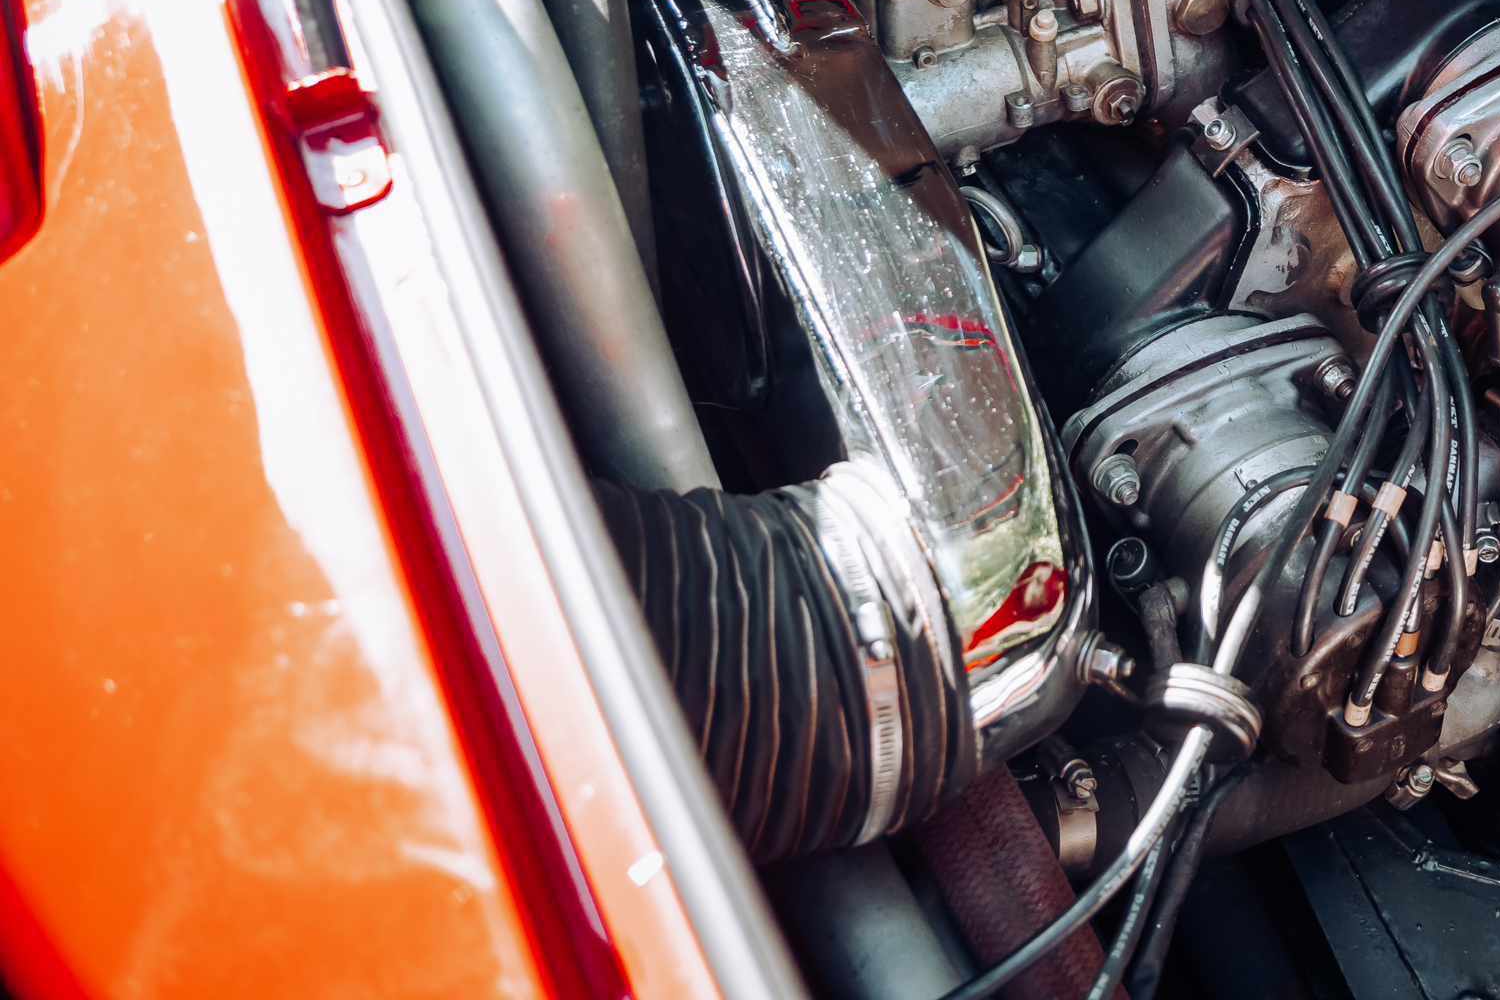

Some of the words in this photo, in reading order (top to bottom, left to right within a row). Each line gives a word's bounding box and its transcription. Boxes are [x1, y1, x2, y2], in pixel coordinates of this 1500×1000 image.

[1445, 438, 1458, 494] DANMAR
[1243, 485, 1272, 513] NKT
[1216, 517, 1241, 566] DANMARK
[1411, 555, 1427, 598] NKT
[1382, 610, 1410, 662] DANMARK
[1364, 672, 1383, 700] NKT
[1110, 893, 1146, 959] DANMARK
